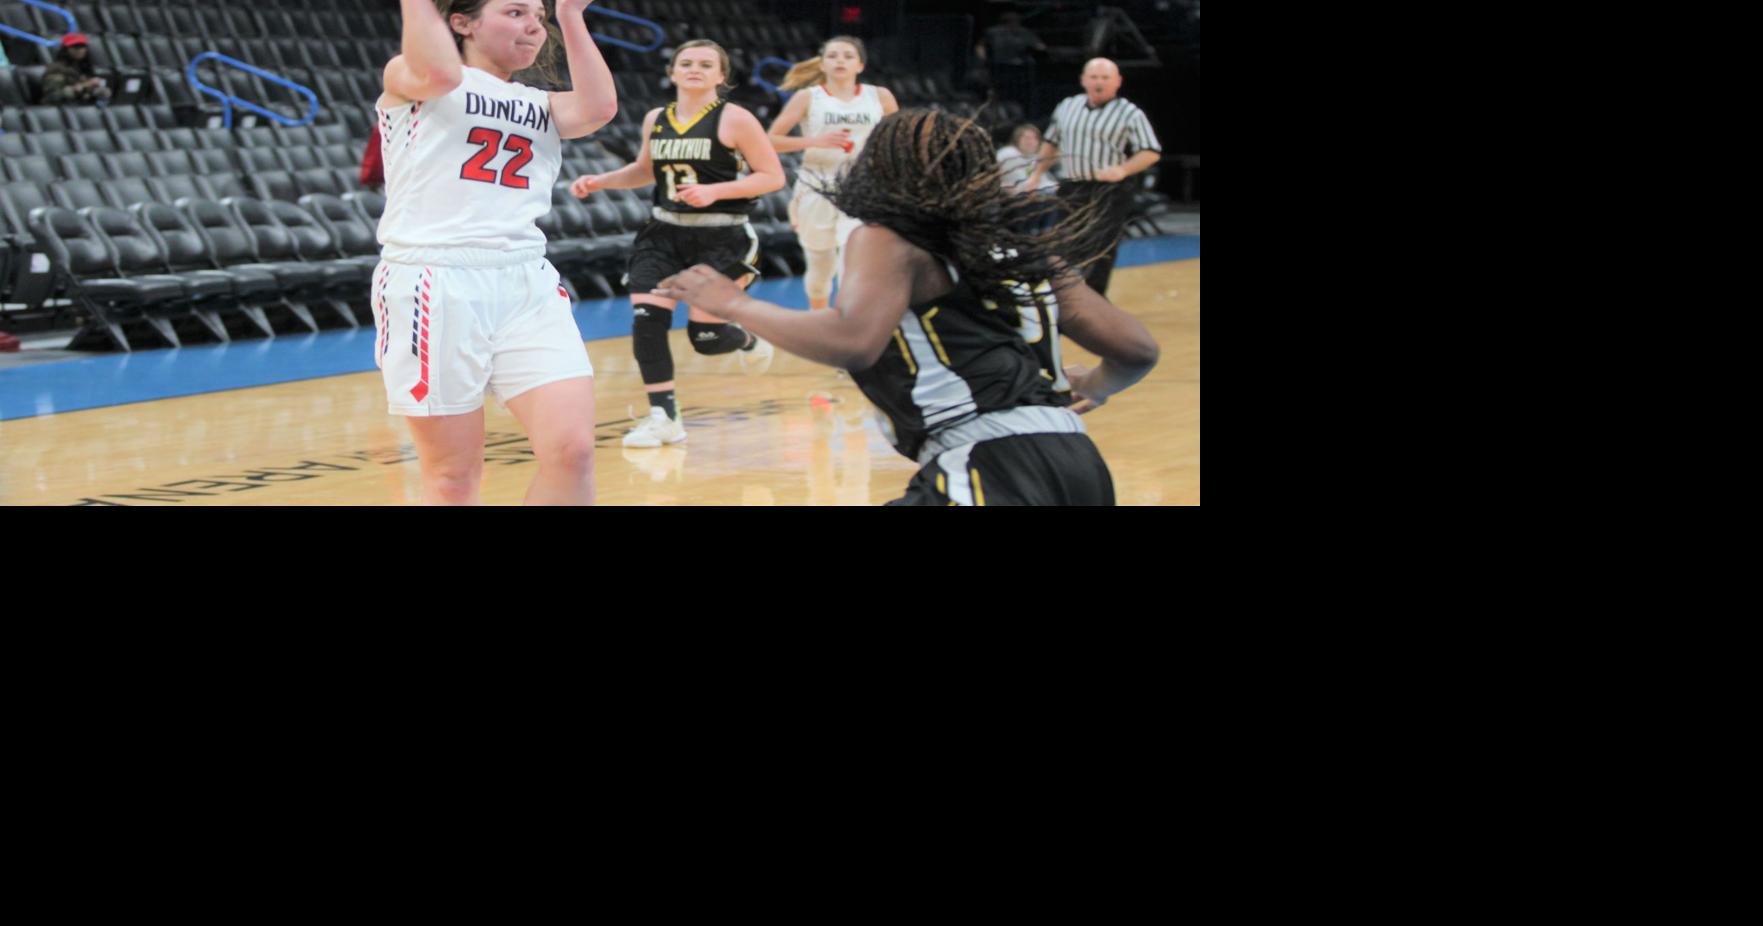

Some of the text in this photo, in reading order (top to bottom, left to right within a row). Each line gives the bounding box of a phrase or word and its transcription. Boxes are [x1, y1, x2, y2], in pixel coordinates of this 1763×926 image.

[465, 91, 550, 133] DUNCAN
[824, 112, 871, 125] DUNCAN
[460, 126, 533, 189] 22
[650, 137, 711, 160] ACARTHUR
